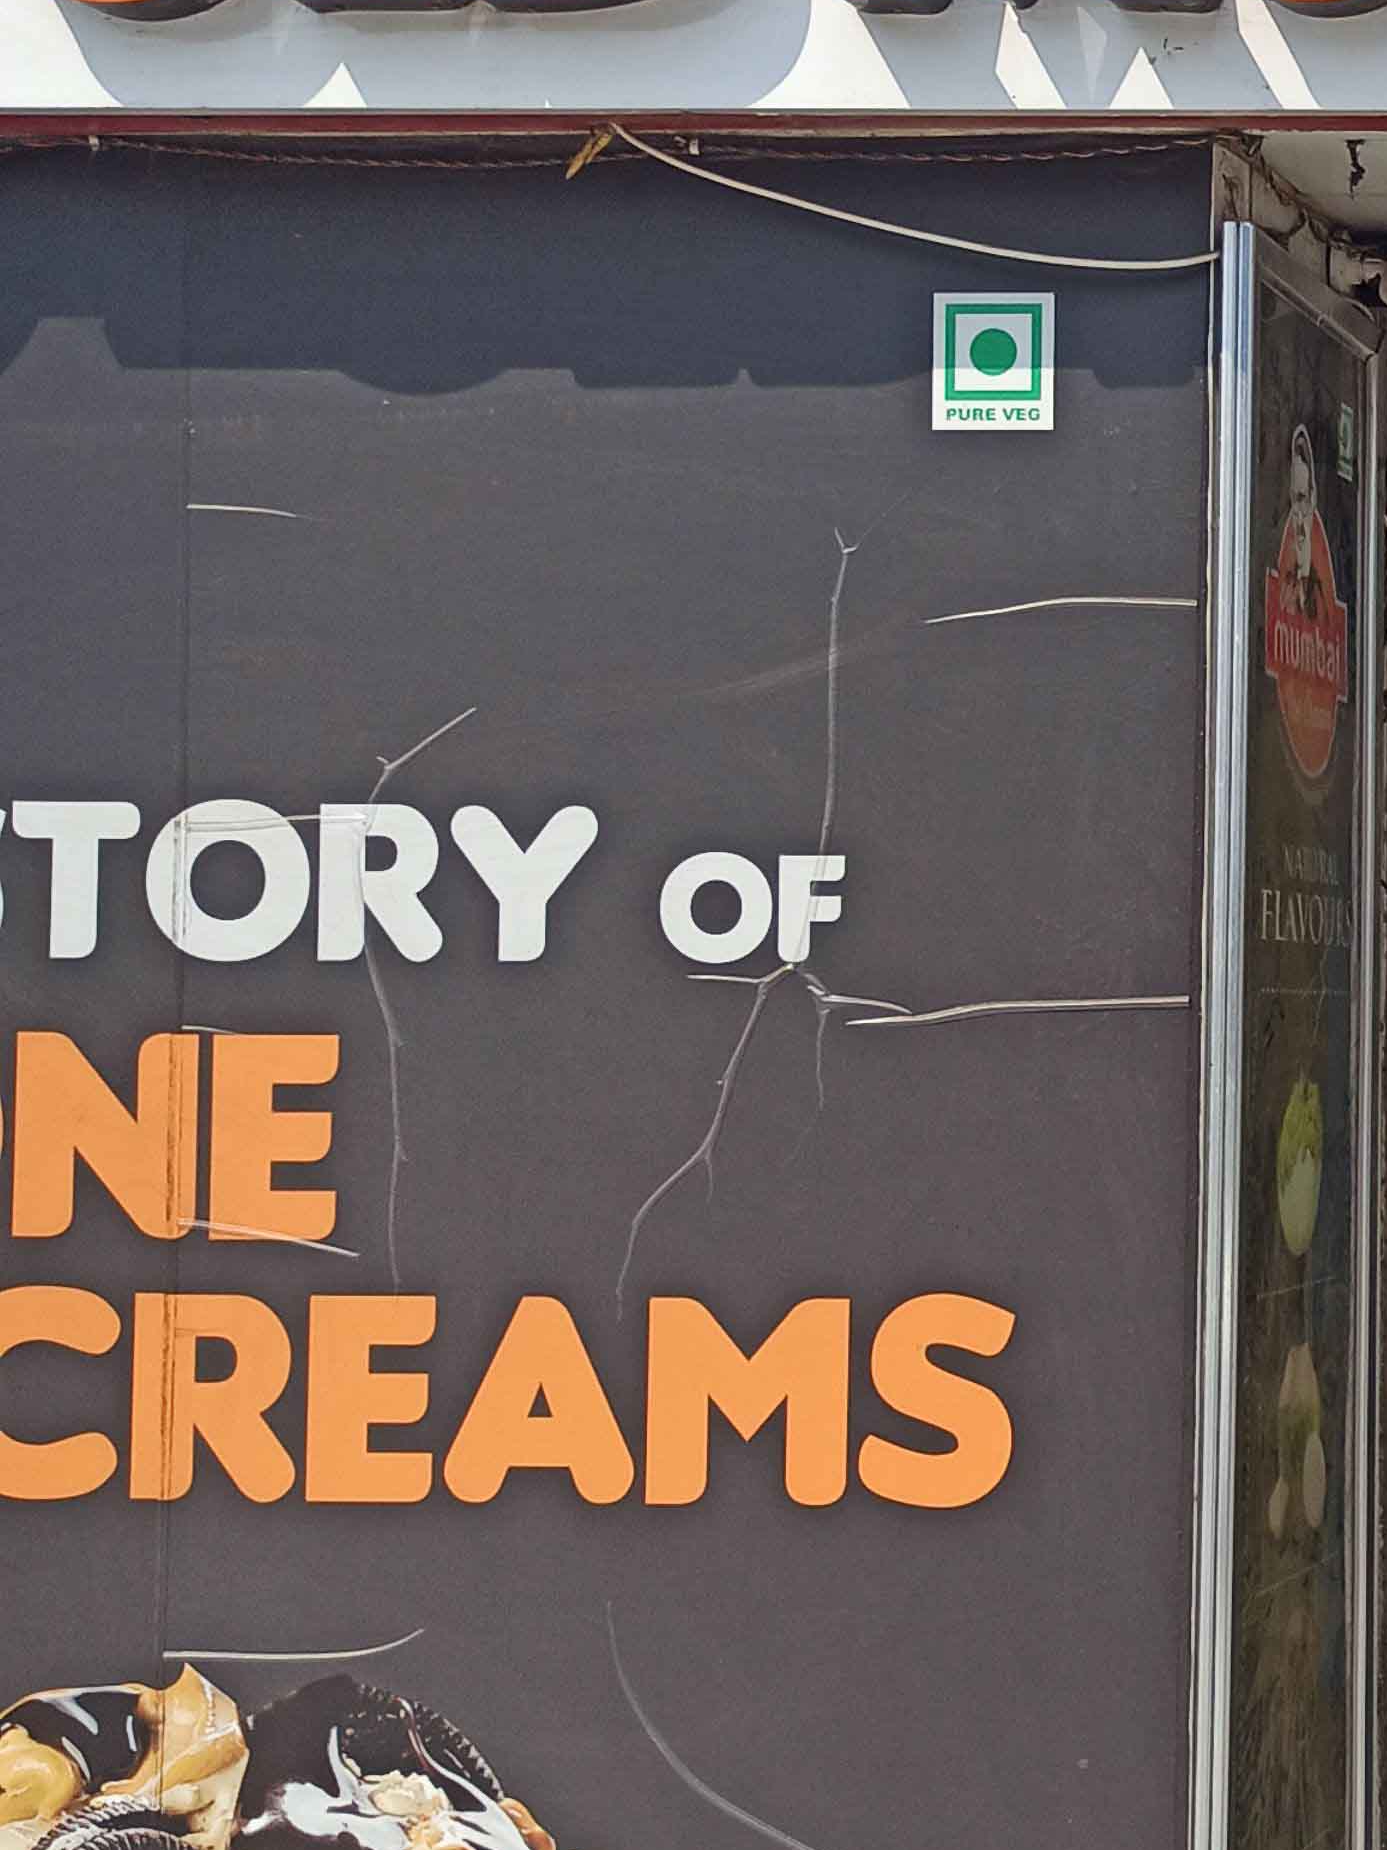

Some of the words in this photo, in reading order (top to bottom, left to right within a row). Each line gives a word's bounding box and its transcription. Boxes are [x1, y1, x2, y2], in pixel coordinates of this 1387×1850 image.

[946, 407, 996, 422] PURE
[1003, 407, 1041, 422] VEG
[1273, 619, 1341, 682] mumbai
[0, 799, 598, 962] TORY
[659, 851, 847, 963] OF
[0, 1030, 340, 1242] NE
[0, 1284, 1016, 1509] CREAMS
